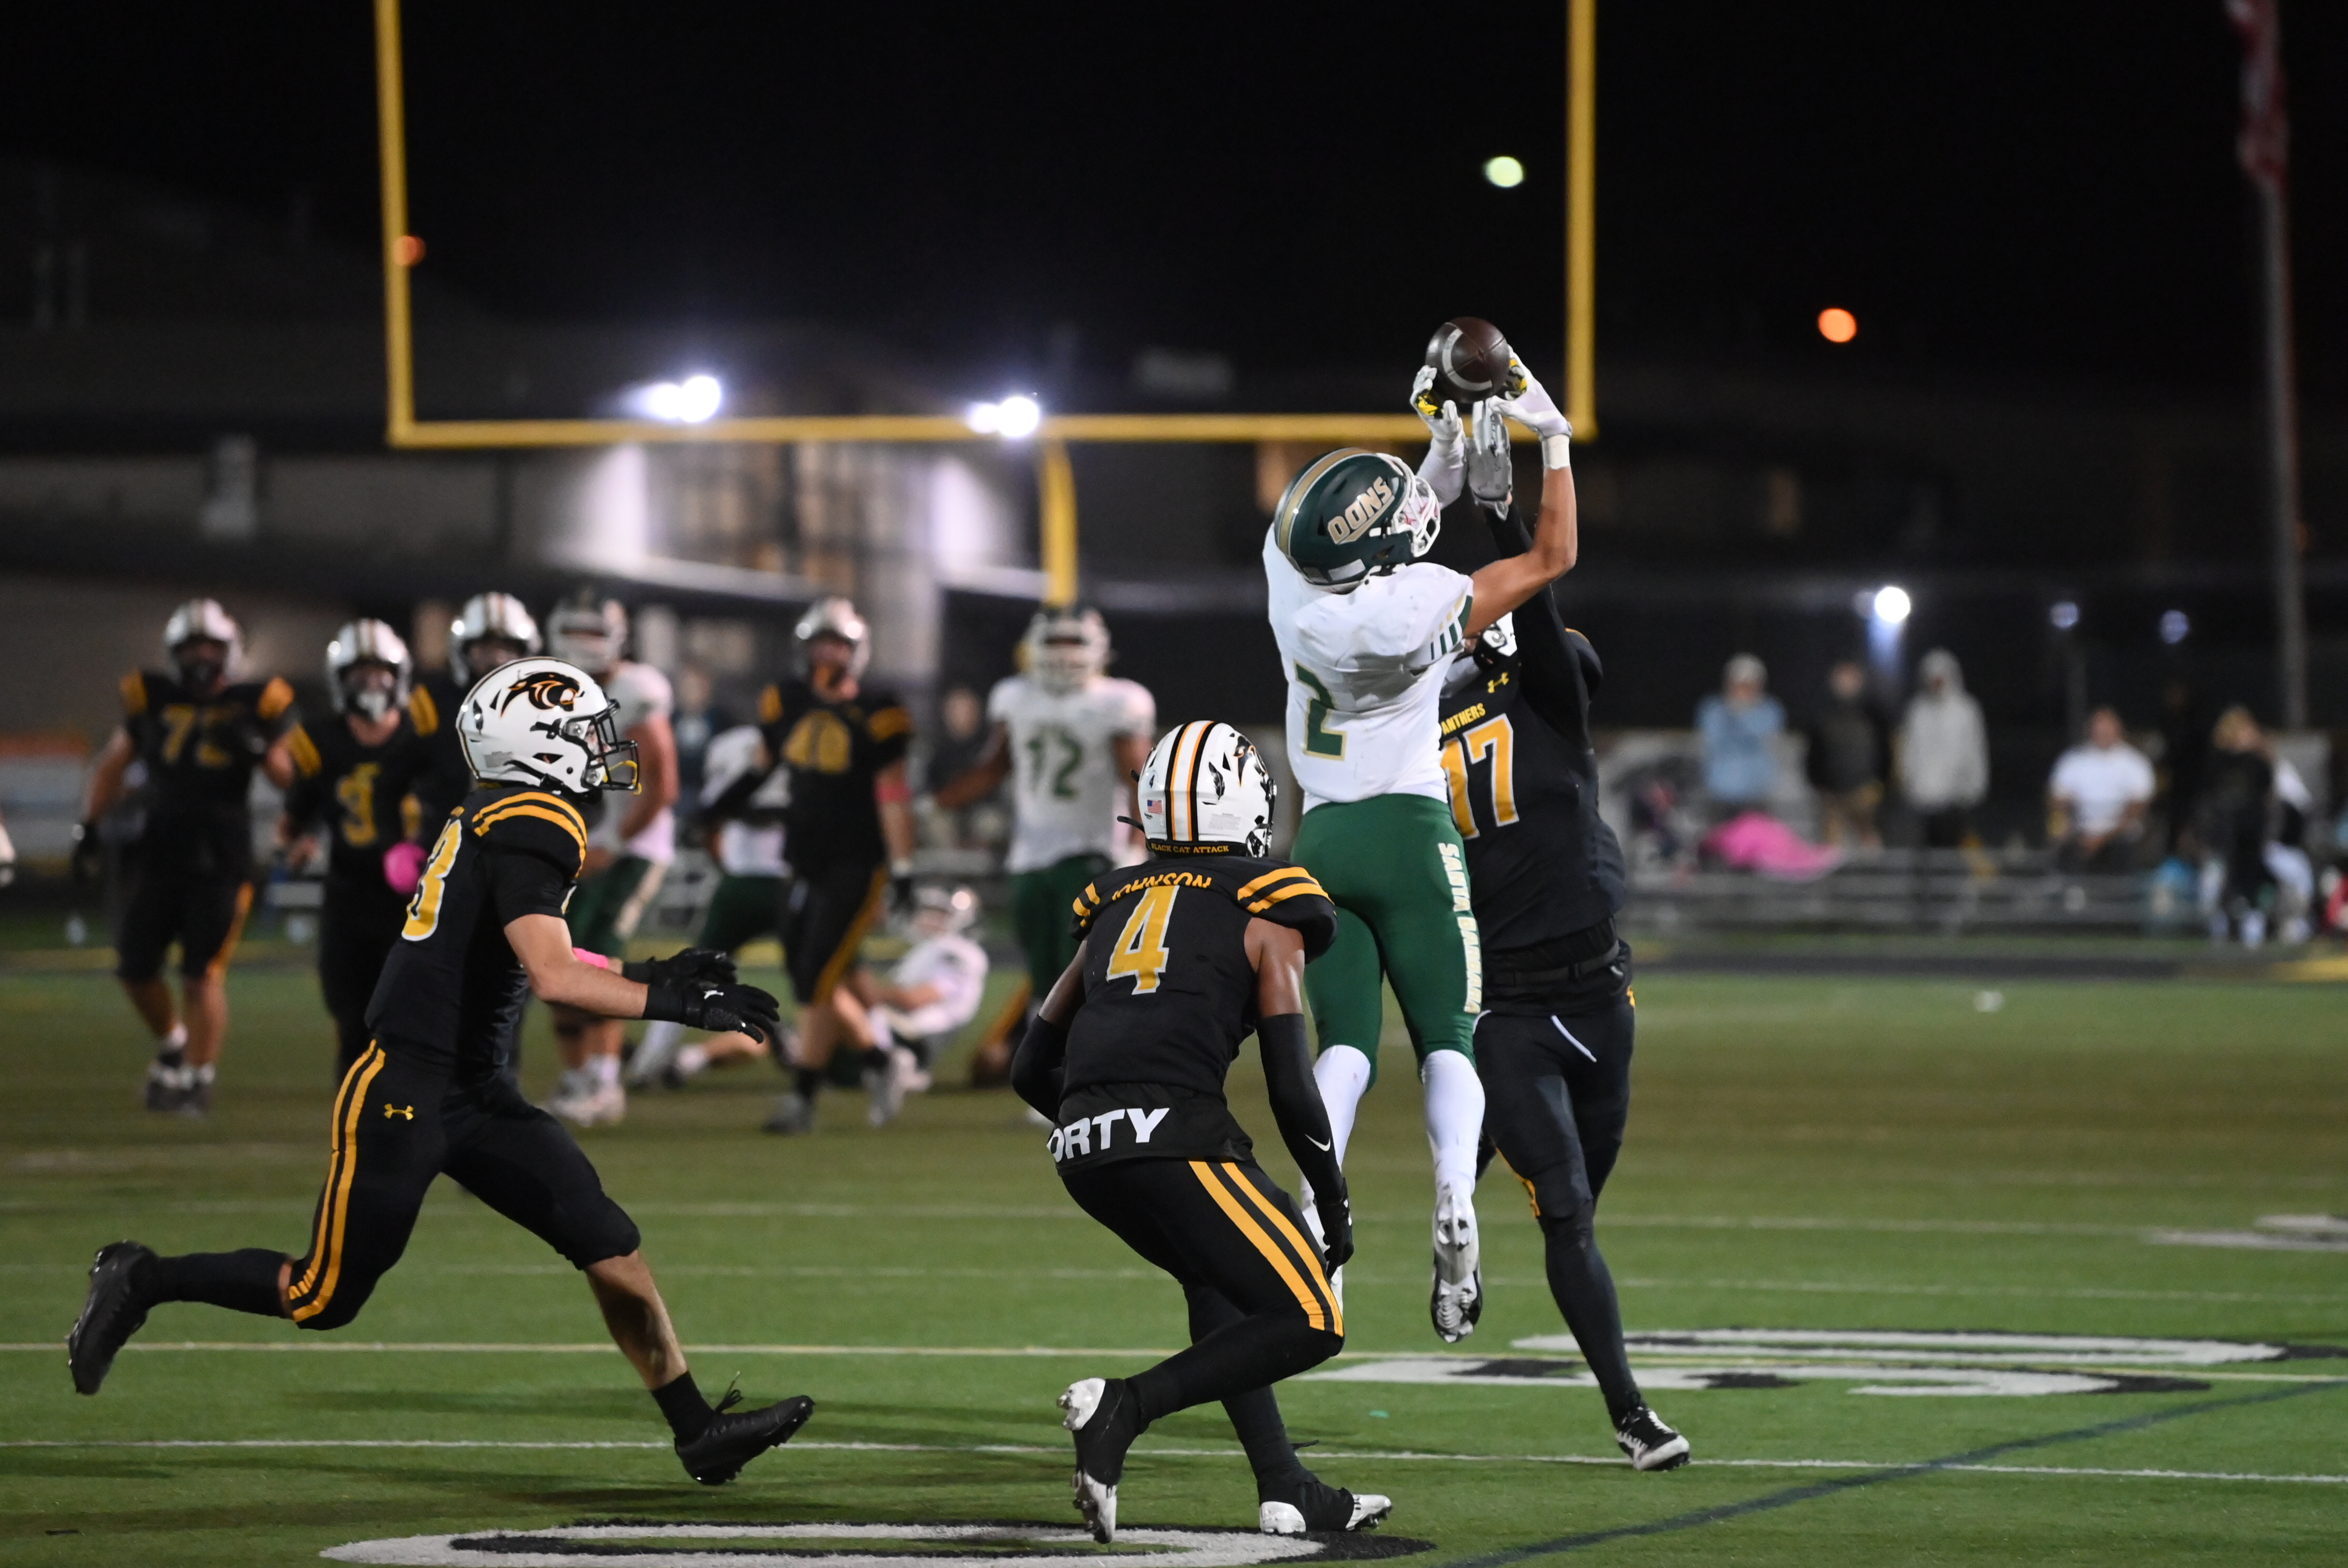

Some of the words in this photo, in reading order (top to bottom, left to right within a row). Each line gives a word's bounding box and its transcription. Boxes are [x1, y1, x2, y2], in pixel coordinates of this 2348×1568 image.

[1327, 476, 1394, 545] DONS
[1293, 658, 1347, 761] 2
[1441, 703, 1486, 735] ANTHERS
[1026, 726, 1082, 798] 12
[1440, 713, 1520, 840] 17
[1151, 843, 1172, 852] BLACK
[1193, 845, 1230, 854] ATTACK
[1438, 842, 1471, 912] SANTA
[1106, 885, 1180, 996] 4
[1046, 1107, 1170, 1162] ORTY
